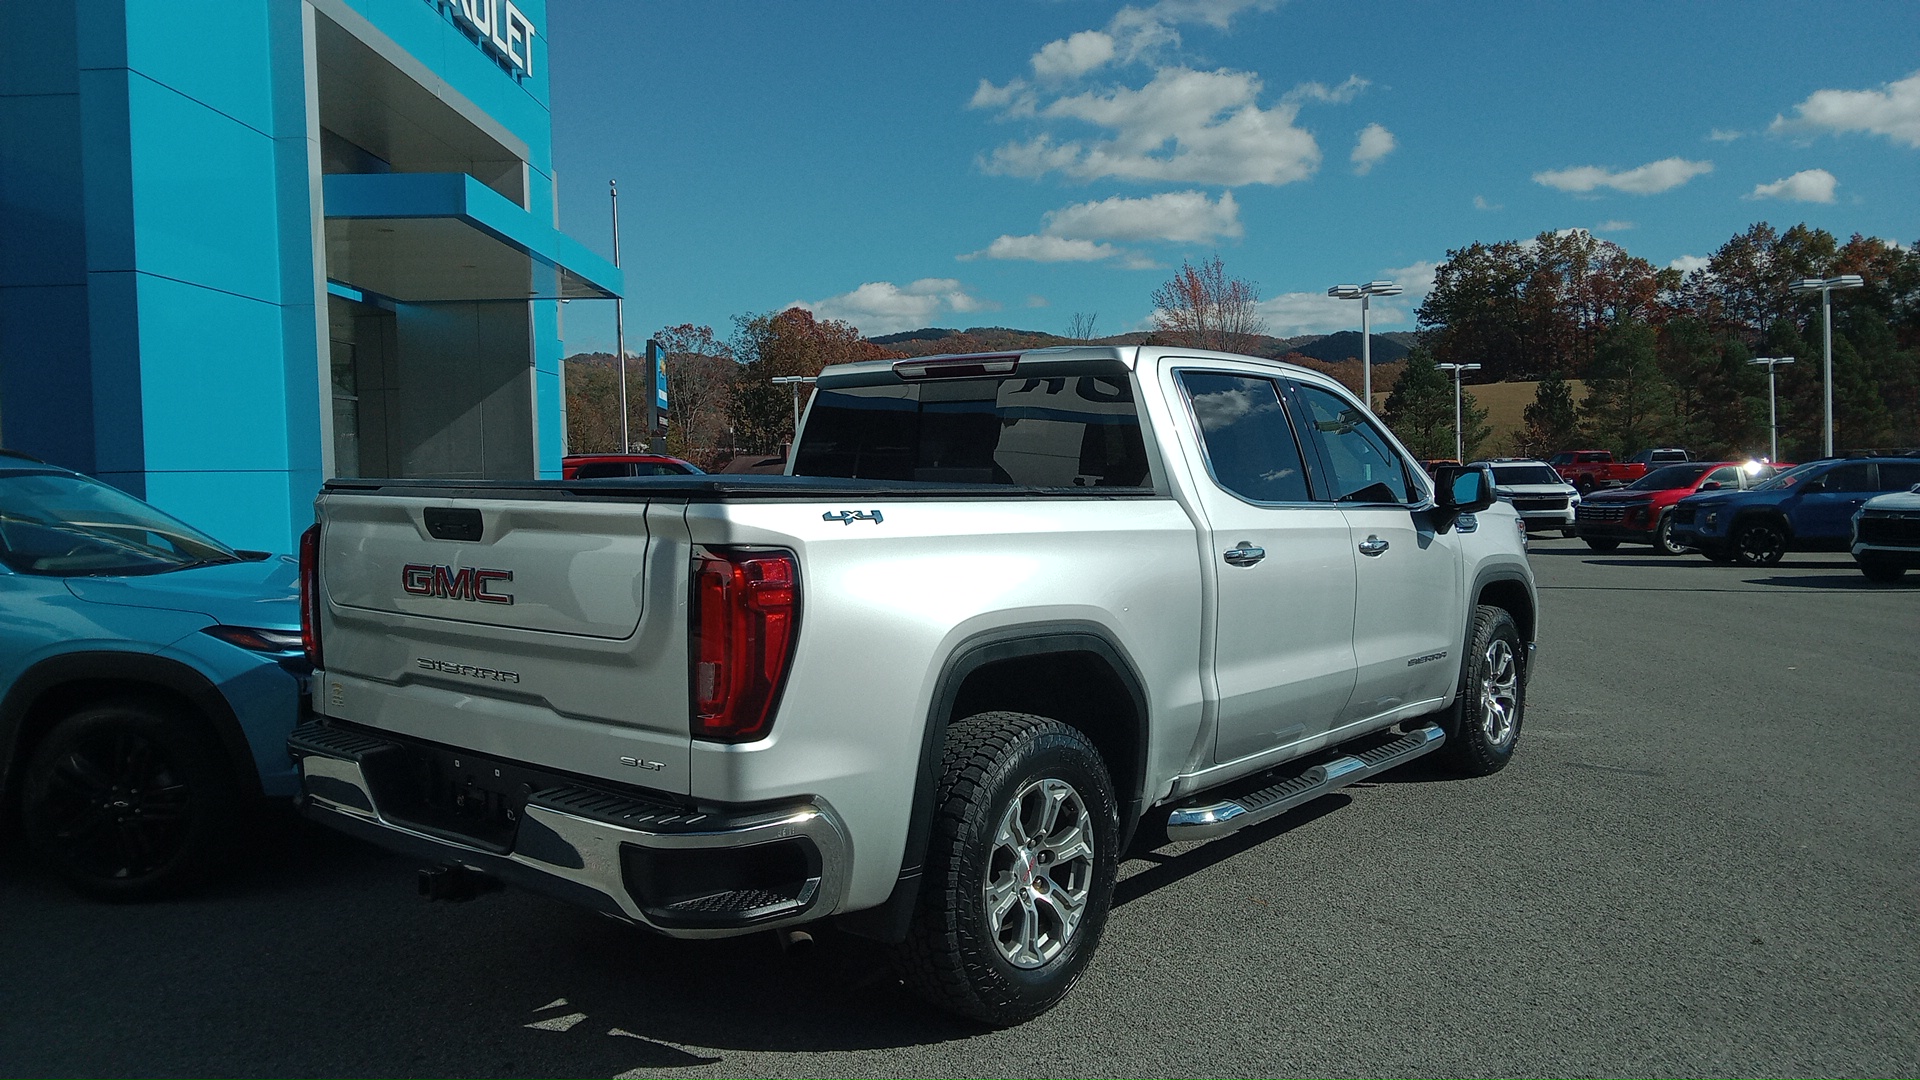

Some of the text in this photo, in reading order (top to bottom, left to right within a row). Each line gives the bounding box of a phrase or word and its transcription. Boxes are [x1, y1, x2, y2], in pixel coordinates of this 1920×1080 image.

[402, 562, 514, 605] GMC
[417, 658, 520, 683] SIERRA
[620, 756, 667, 771] SLT
